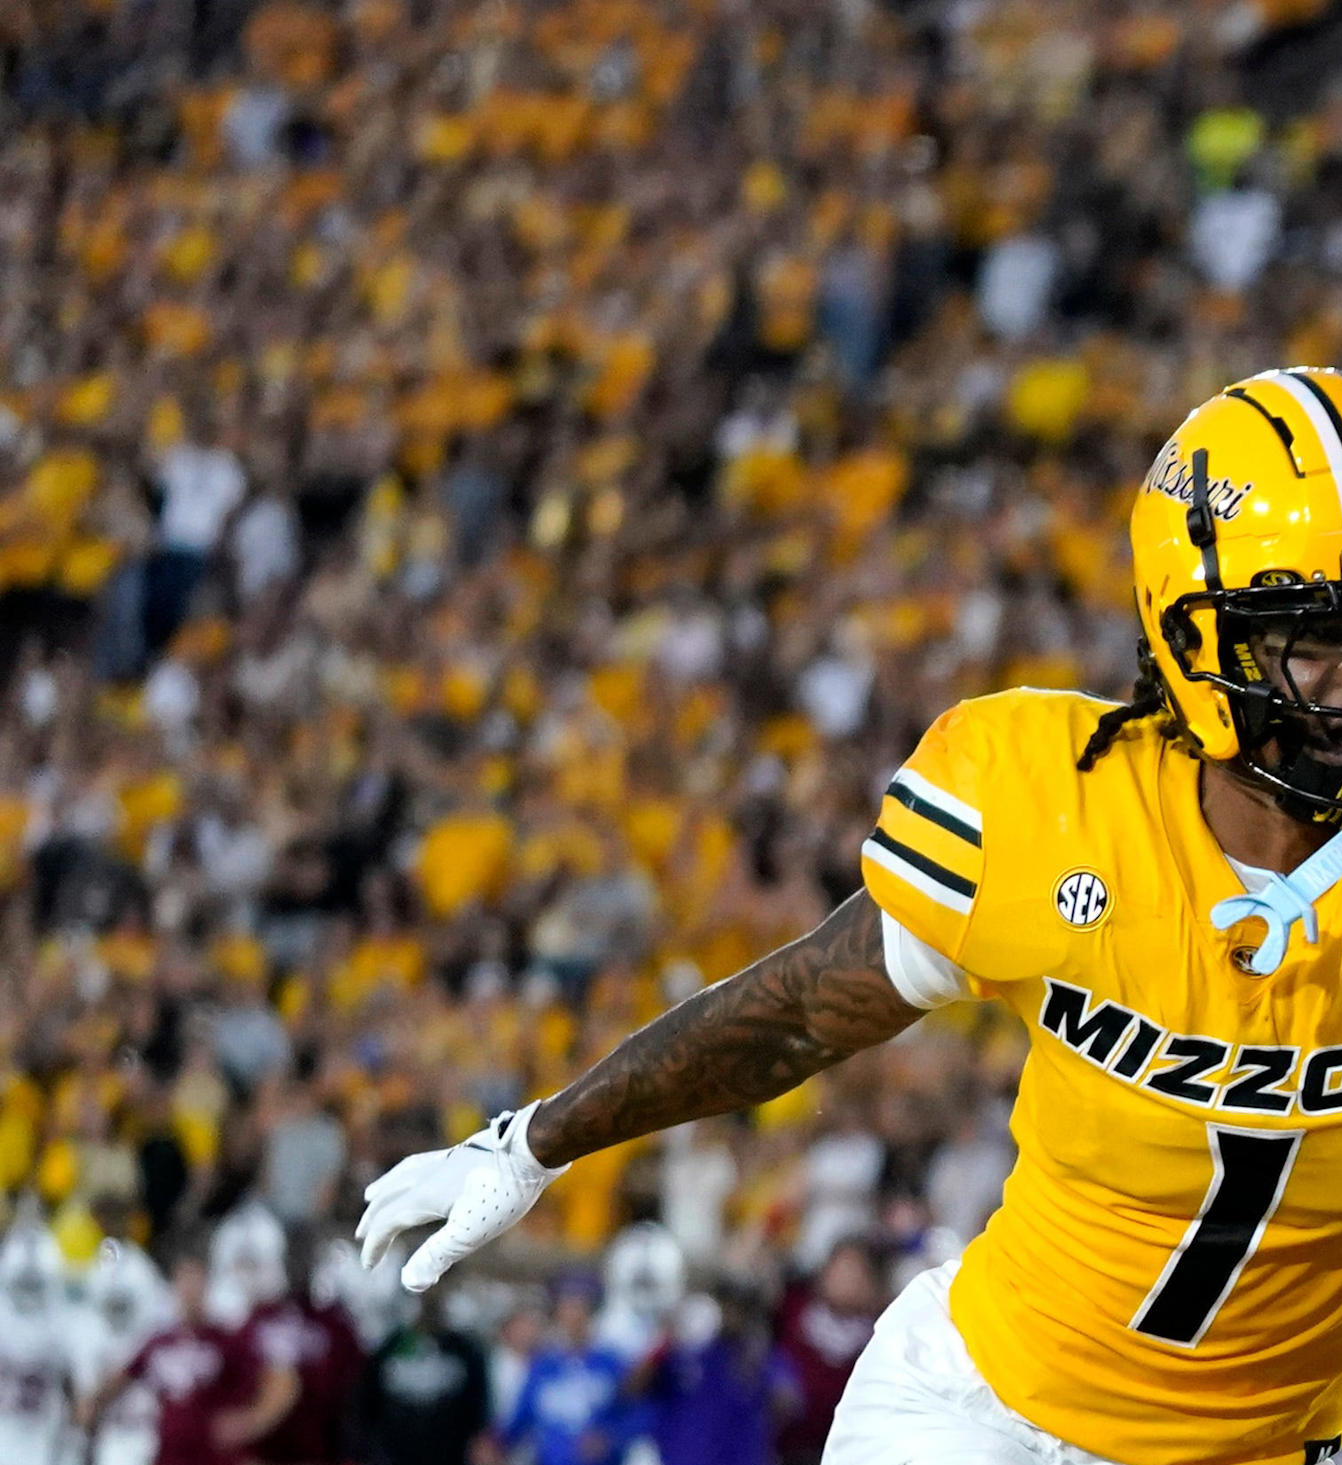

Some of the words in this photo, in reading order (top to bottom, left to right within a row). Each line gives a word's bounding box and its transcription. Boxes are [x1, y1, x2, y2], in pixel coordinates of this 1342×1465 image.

[1233, 643, 1264, 682] MIZ
[1057, 872, 1108, 925] SEC
[1127, 1122, 1307, 1350] 1
